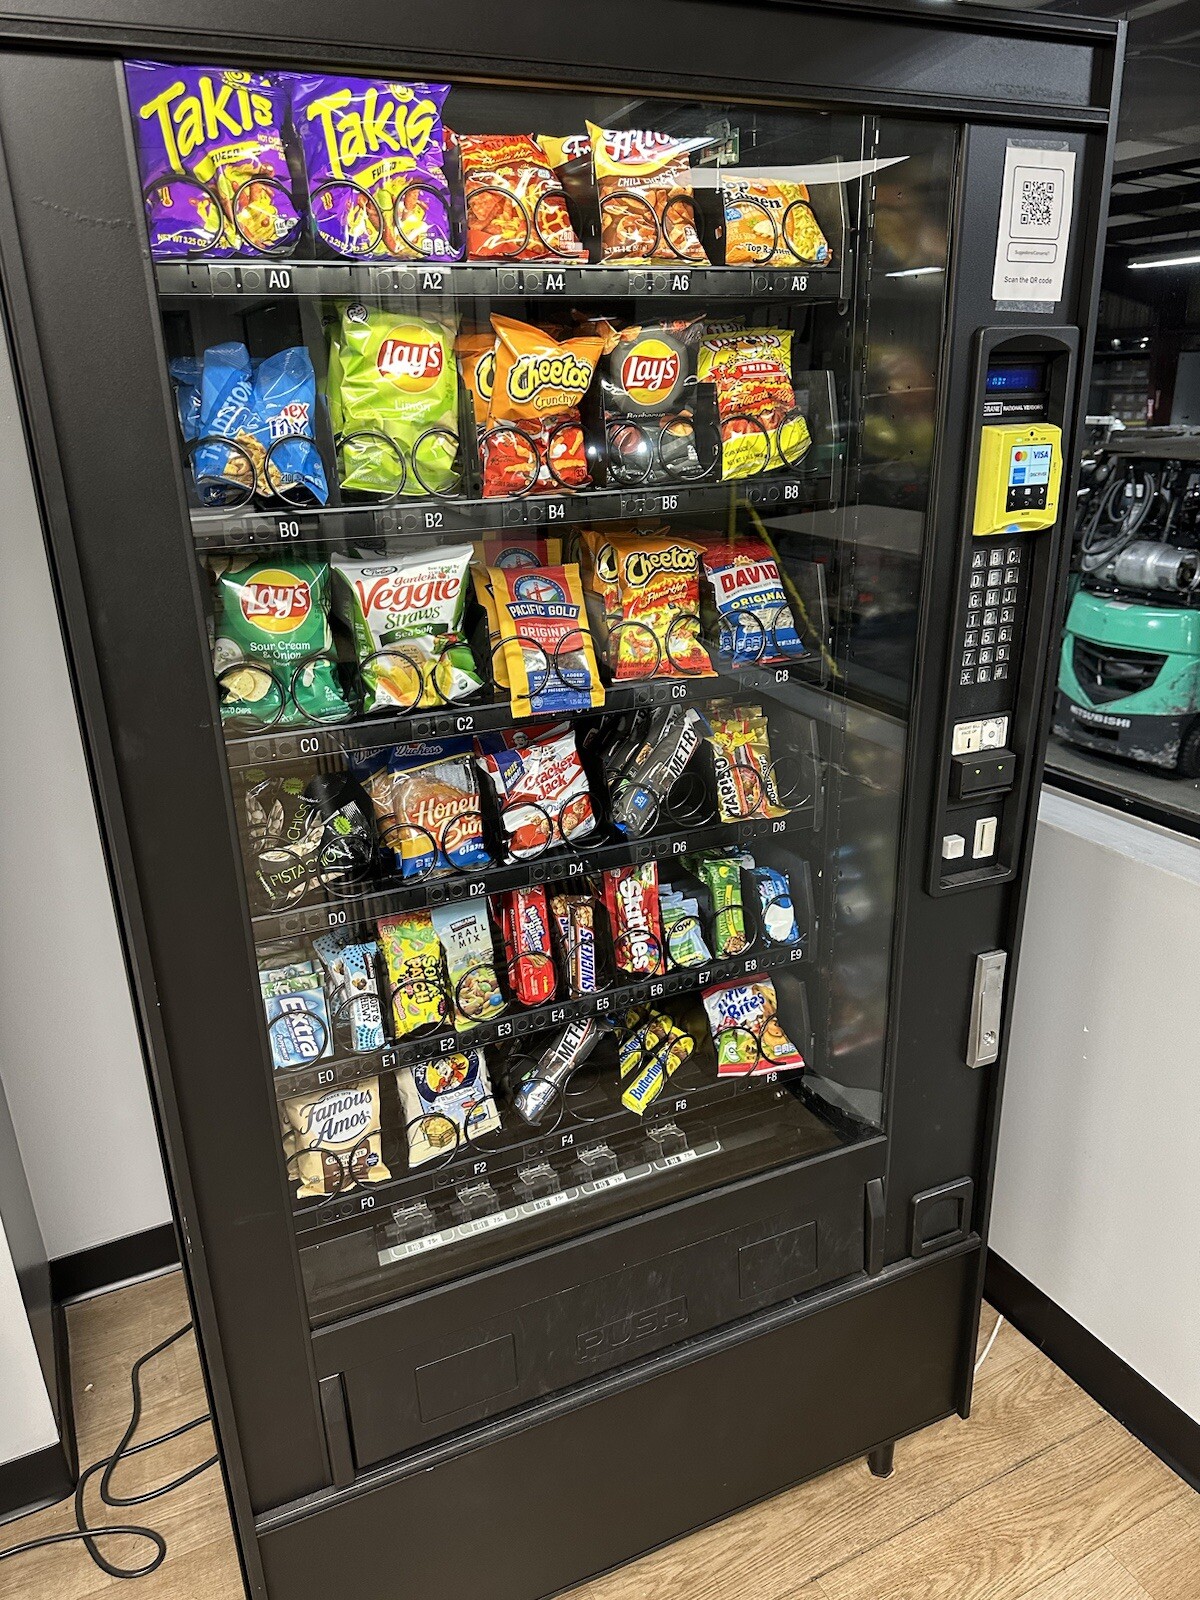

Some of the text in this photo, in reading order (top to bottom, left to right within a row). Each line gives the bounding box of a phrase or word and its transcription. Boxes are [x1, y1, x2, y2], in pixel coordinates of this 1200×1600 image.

[140, 76, 273, 175] Takis
[307, 88, 436, 180] Takis
[371, 161, 397, 179] FUO
[746, 243, 762, 254] Top
[269, 270, 290, 289] A0
[423, 272, 442, 290] A2
[546, 274, 564, 290] A4
[672, 275, 689, 290] A6
[791, 276, 807, 291] A8
[1004, 275, 1018, 283] Scan
[1029, 276, 1038, 284] QR
[380, 340, 441, 379] Lay's
[625, 356, 677, 391] Lay's
[742, 363, 774, 372] FRIES
[508, 353, 592, 402] Cheetos
[534, 392, 577, 411] Crunchy
[1033, 450, 1049, 459] VISA
[784, 486, 799, 499] B8
[662, 496, 678, 509] B6
[550, 505, 565, 518] B4
[425, 513, 443, 527] B2
[279, 522, 299, 537] B0
[626, 546, 697, 585] Cheetos
[392, 573, 434, 587] garden
[720, 564, 779, 593] DAVID
[247, 583, 308, 618] Lay's
[355, 576, 460, 619] Veggie
[731, 591, 787, 610] ORIGINAL
[384, 606, 443, 630] Straws
[509, 604, 579, 618] PACIFIC GOLD
[395, 624, 434, 640] Sea Salt
[520, 625, 574, 637] ORIGINAL
[250, 641, 310, 651] Sour Cream
[273, 650, 301, 660] Onion
[775, 669, 789, 683] C8
[672, 685, 687, 698] C6
[457, 717, 473, 730] C2
[1070, 704, 1131, 728] MITSUBISHI
[300, 738, 319, 751] C0
[394, 743, 443, 757] Duchess
[524, 753, 576, 791] Cracker
[536, 773, 568, 801] Jack
[714, 757, 741, 817] HARIBO
[412, 795, 480, 827] Honey
[434, 815, 483, 850] Bun
[772, 820, 786, 833] D8
[673, 841, 687, 854] D6
[569, 862, 584, 875] D4
[470, 882, 486, 896] D2
[329, 911, 347, 925] D0
[525, 905, 546, 936] Nutter
[619, 877, 651, 969] Skittles
[450, 924, 487, 942] TRAIL
[523, 922, 544, 952] Butter
[458, 933, 481, 949] MIX
[579, 928, 594, 992] SNICKERS
[790, 949, 802, 961] E9
[745, 960, 757, 972] E8
[407, 955, 431, 1004] PATCH
[698, 971, 711, 984] E7
[650, 984, 663, 996] E6
[596, 996, 609, 1010] E5
[728, 992, 766, 1020] Bites
[551, 1008, 565, 1021] E4
[279, 996, 320, 1058] Extra
[497, 1022, 512, 1036] E3
[440, 1038, 455, 1051] E2
[382, 1054, 396, 1067] E1
[318, 1069, 334, 1084] E0
[766, 1071, 778, 1083] F8
[300, 1089, 373, 1135] Famous
[675, 1099, 687, 1111] F6
[309, 1109, 371, 1149] Amos
[561, 1133, 574, 1146] F4
[474, 1162, 487, 1174] F2
[361, 1196, 375, 1210] F0
[581, 1302, 686, 1360] PUSH
